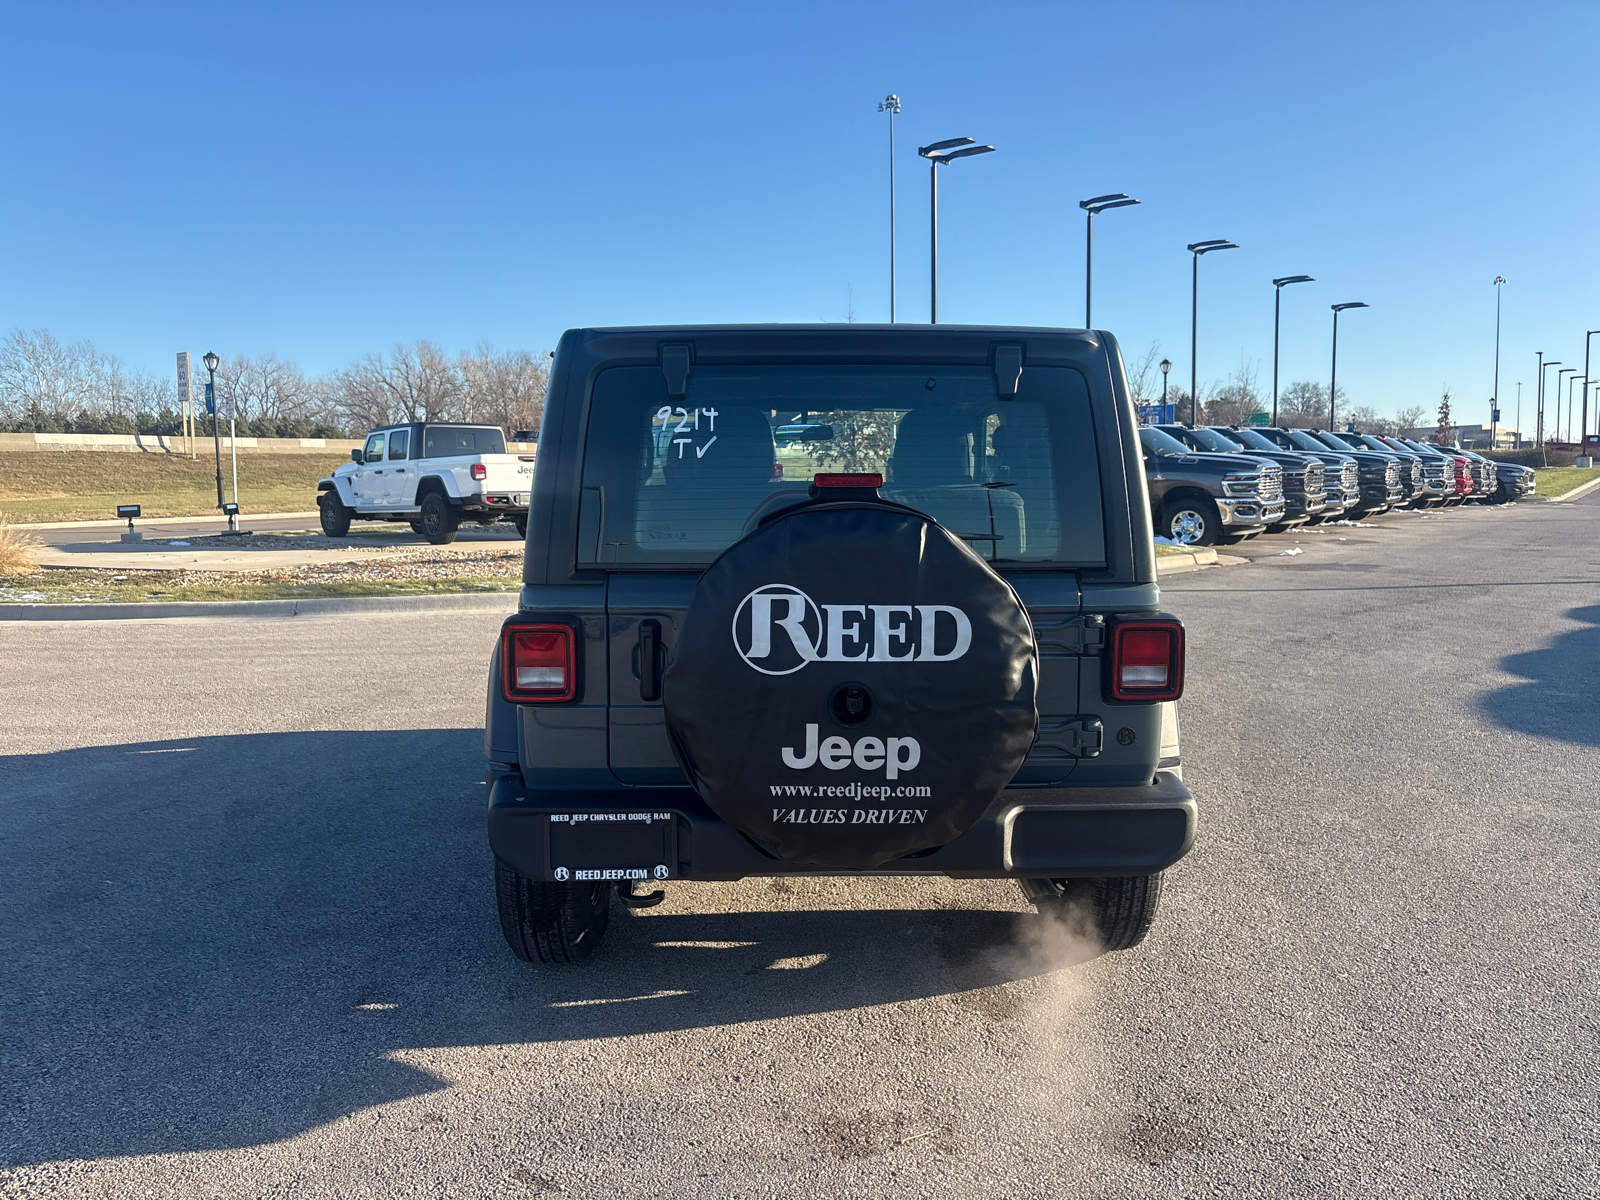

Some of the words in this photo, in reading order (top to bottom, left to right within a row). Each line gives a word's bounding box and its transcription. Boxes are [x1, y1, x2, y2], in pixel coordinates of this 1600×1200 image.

[657, 405, 719, 433] 9214
[517, 465, 535, 474] Jee
[744, 593, 973, 663] REED
[781, 723, 921, 780] Jeep
[769, 782, 932, 801] www.reedjeep.com
[550, 814, 570, 822] REED
[571, 814, 589, 822] JEEP
[589, 813, 627, 821] CHRYSLER
[628, 812, 652, 821] DODGE
[653, 812, 671, 820] RAM
[771, 808, 848, 824] VALUES
[850, 808, 928, 824] DRIVEN
[575, 869, 648, 880] REEDJEEP.COM
